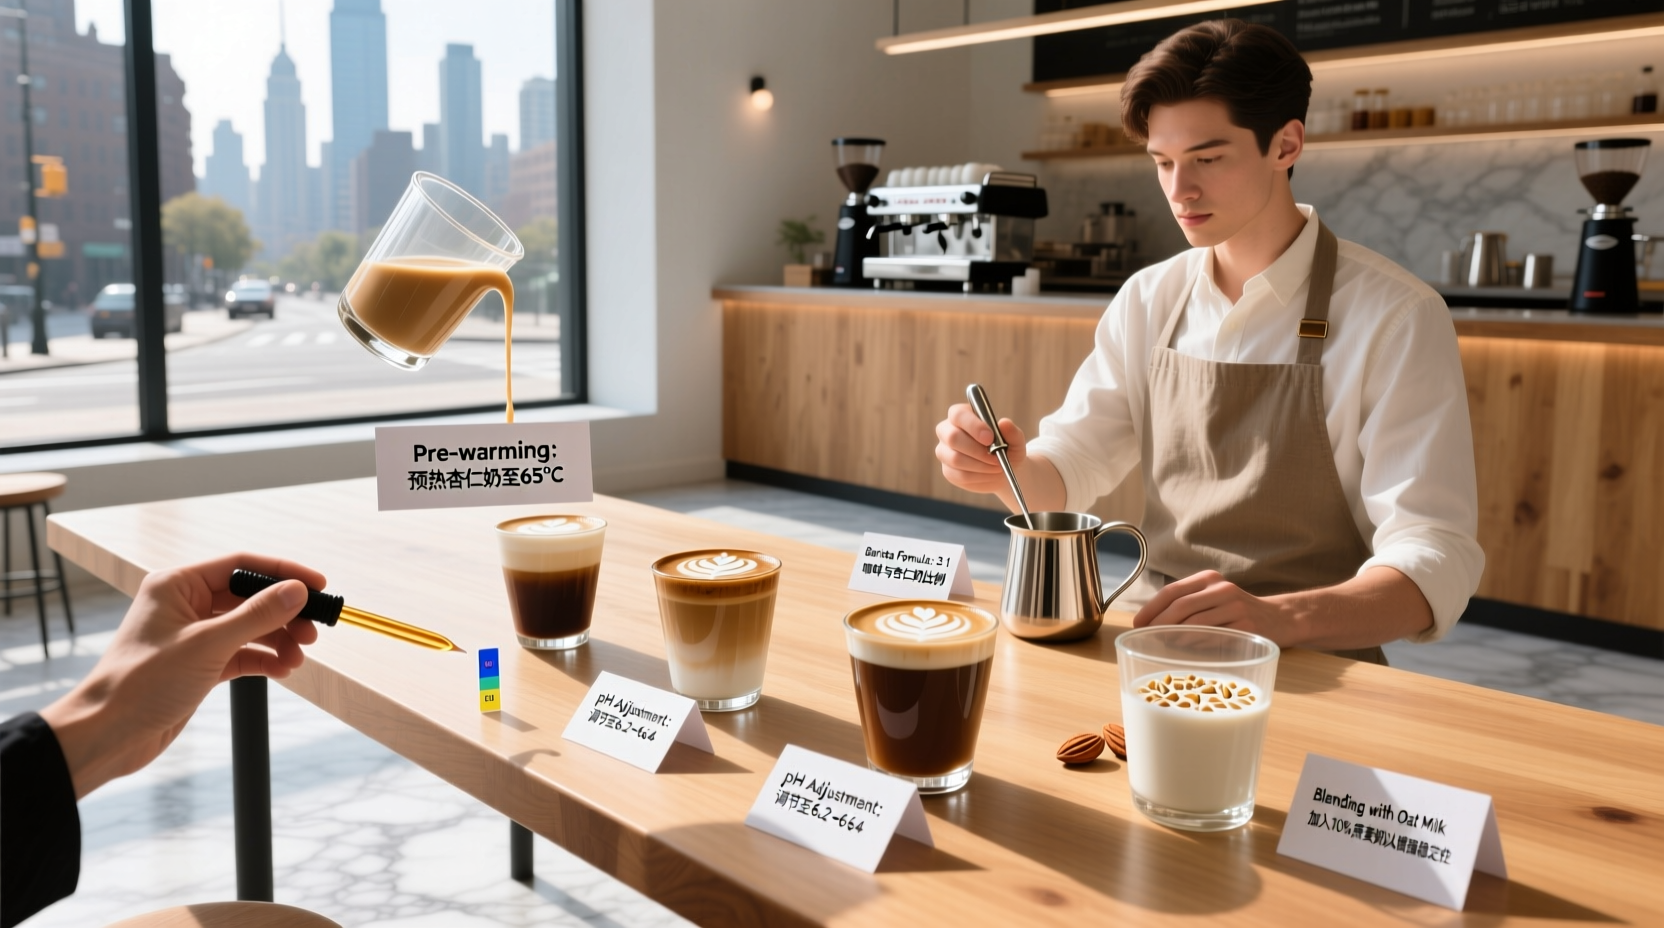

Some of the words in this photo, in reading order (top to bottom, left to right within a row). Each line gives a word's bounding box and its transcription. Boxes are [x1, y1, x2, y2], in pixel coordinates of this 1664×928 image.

[413, 440, 557, 463] Pre-warming:
[595, 693, 616, 707] pH
[780, 772, 806, 788] pH
[1313, 787, 1365, 818] Blending
[1369, 803, 1394, 821] with
[1397, 809, 1419, 828] Oat
[1421, 815, 1447, 836] Milk
